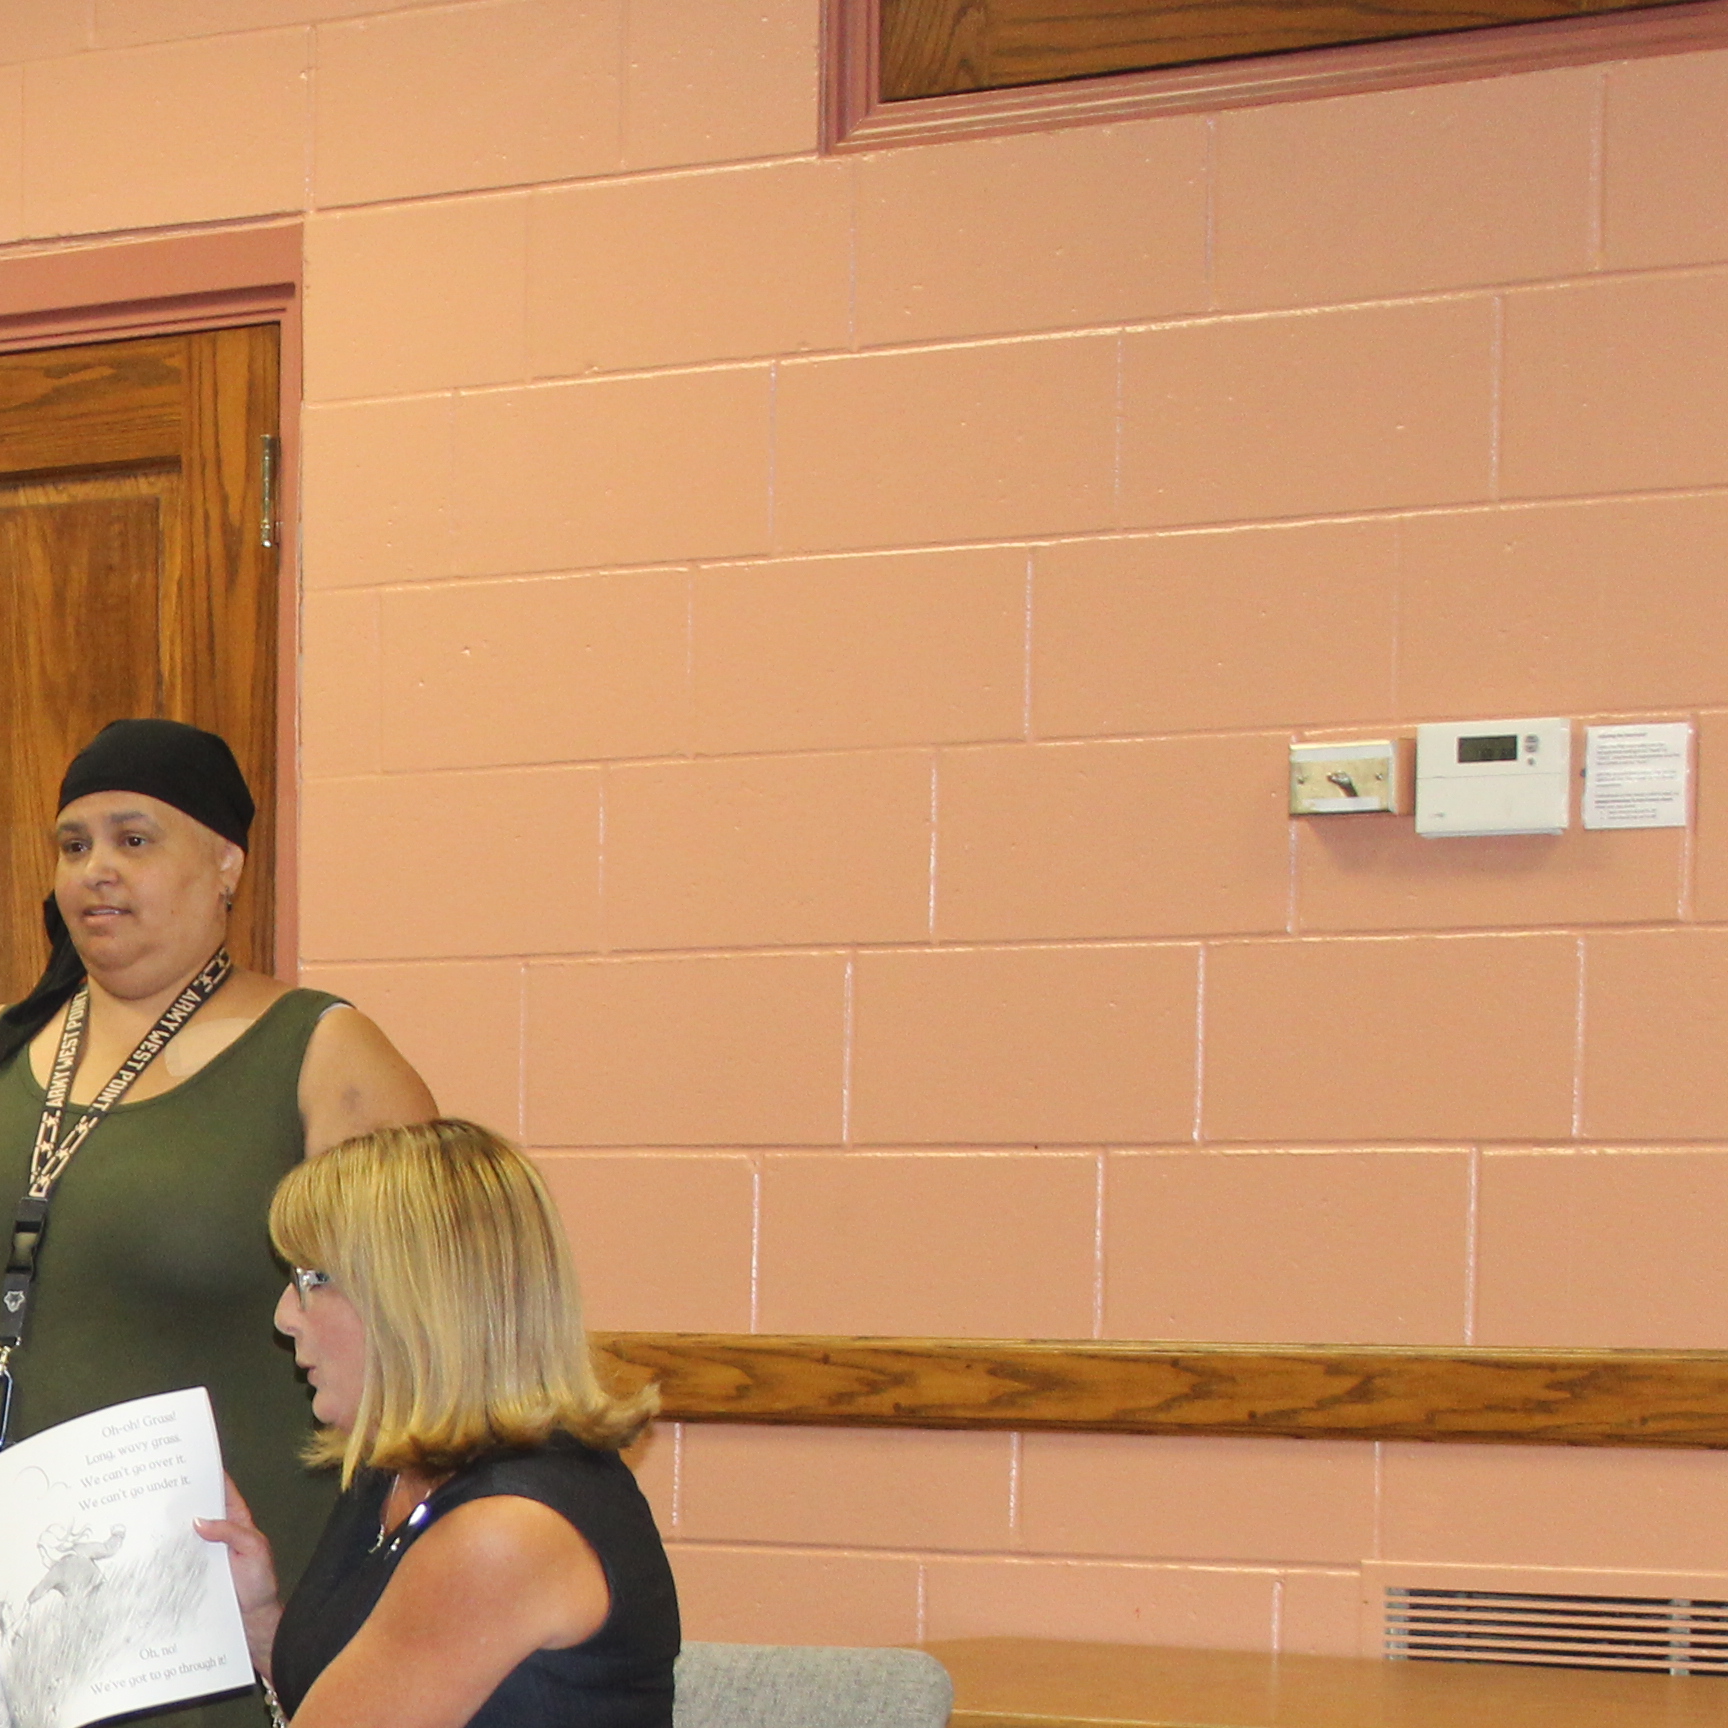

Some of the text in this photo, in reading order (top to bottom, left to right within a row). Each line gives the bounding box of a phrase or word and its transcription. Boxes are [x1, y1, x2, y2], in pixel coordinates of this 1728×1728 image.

[55, 1031, 80, 1071] WEST
[92, 988, 202, 1111] ARMY WEST POINT
[46, 1070, 71, 1108] ARMY
[101, 1410, 177, 1438] Oh-oh! Grass!
[118, 1440, 149, 1455] wavy
[80, 1454, 187, 1488] We can't go over it.
[78, 1497, 99, 1511] We
[100, 1488, 127, 1505] can't
[130, 1485, 144, 1498] go
[146, 1477, 180, 1492] under
[139, 1643, 178, 1661] Oh, no!
[89, 1653, 227, 1695] We've got to go through it!
